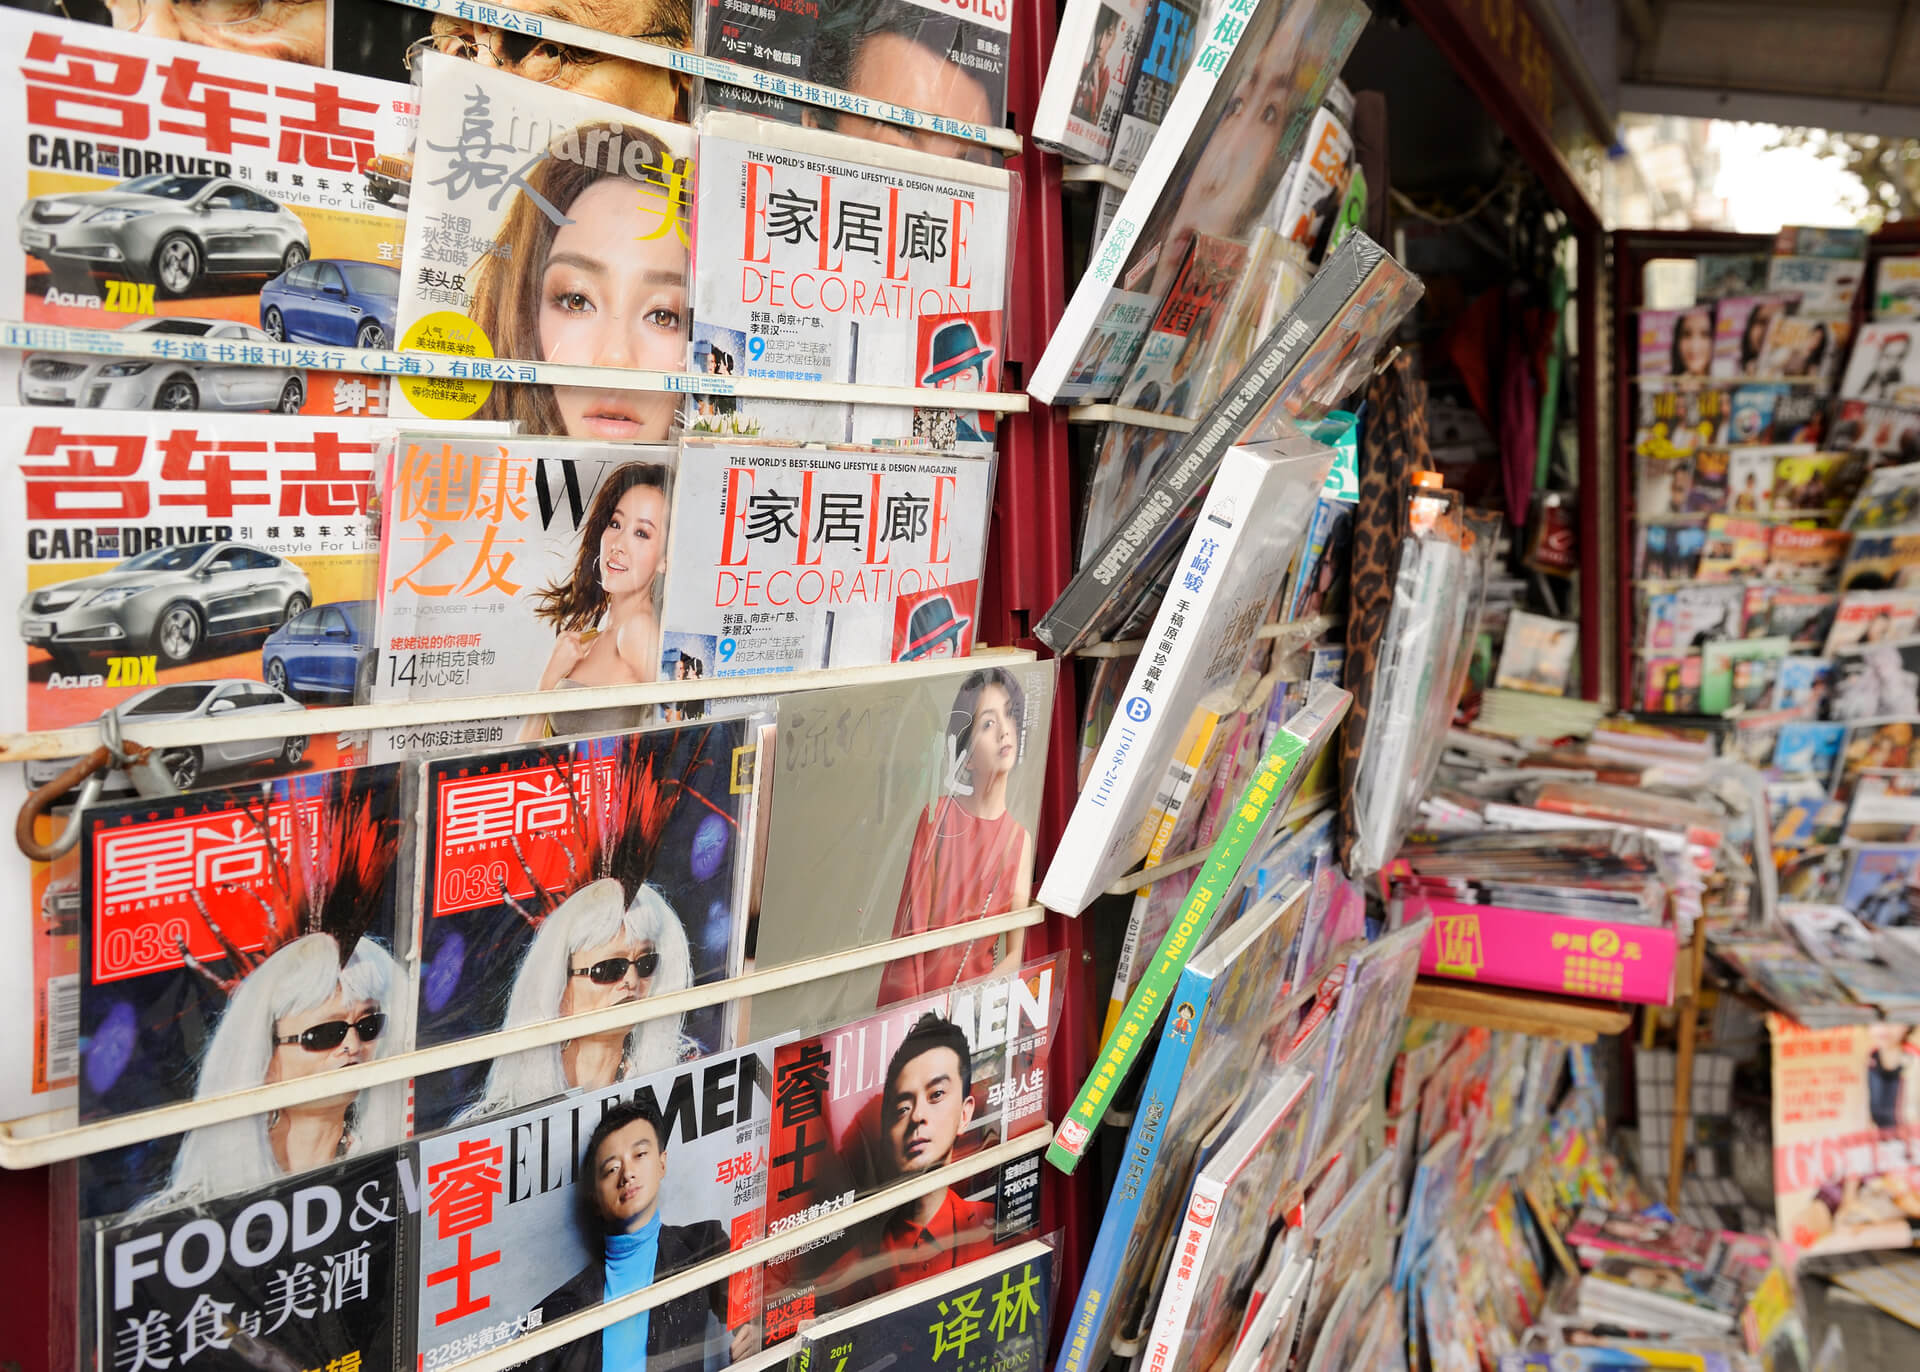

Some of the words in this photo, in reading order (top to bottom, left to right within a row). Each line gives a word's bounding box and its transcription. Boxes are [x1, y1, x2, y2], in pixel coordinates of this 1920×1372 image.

[754, 45, 801, 67] 这个敏感词
[19, 31, 380, 174] 名车志
[753, 72, 987, 142] 华道书报刊发行（上海）有限公司
[28, 133, 94, 173] CAR
[122, 147, 232, 178] DRIVER
[426, 84, 577, 226] 嘉人
[747, 150, 764, 162] THE
[766, 153, 805, 169] WORLD'S
[807, 161, 859, 178] BEST-SELLING
[861, 172, 896, 186] LIFESTYLE
[897, 178, 904, 187] &
[905, 179, 934, 193] DESIGN
[935, 185, 975, 200] MAGAZINE
[320, 194, 342, 206] For
[350, 198, 375, 211] Life
[421, 226, 513, 259] 秋冬彩妆热点
[424, 213, 471, 234] 一张图
[738, 160, 975, 289] ELLE
[766, 188, 950, 264] 家居廊
[421, 243, 469, 267] 全知晓
[44, 286, 101, 310] Acura
[104, 279, 156, 315] ZDX
[415, 286, 476, 309] 才有美肌肤
[418, 267, 466, 292] 美头皮
[741, 265, 971, 323] DECORATION
[416, 337, 476, 356] 美妆精英学院
[422, 325, 443, 338] 人气
[748, 336, 766, 362] 9
[152, 338, 537, 383] 华道书报刊发行（上海）有限公司
[730, 456, 747, 466] THE
[748, 457, 787, 468] WORLD'S
[788, 458, 841, 470] BEST-SELLING
[843, 460, 878, 471] LIFESTYLE
[880, 463, 886, 472] &
[888, 463, 917, 473] DESIGN
[918, 464, 957, 474] MAGAZINE
[1092, 540, 1134, 584] SUPER
[1170, 454, 1202, 489] SUPER
[1195, 417, 1231, 456] JUNIOR
[1225, 397, 1246, 418] THE
[1240, 376, 1262, 399] 3RD
[1258, 350, 1283, 377] ASIA
[1279, 320, 1307, 350] TOUR
[19, 426, 379, 520] 名车志
[393, 443, 533, 523] 健康
[714, 467, 956, 567] ELLE
[745, 489, 931, 545] 家居廊
[28, 527, 94, 559] CAR
[122, 526, 232, 558] DRIVER
[321, 541, 343, 551] For
[352, 541, 377, 551] Life
[392, 521, 525, 598] 之友
[715, 567, 950, 608] DECORATION
[390, 633, 482, 650] 姥姥说的你得听
[718, 637, 737, 663] 9
[47, 671, 103, 691] Acura
[106, 655, 158, 688] ZDX
[388, 654, 417, 687] 14
[420, 650, 496, 668] 种相克食物
[1130, 698, 1150, 721] B
[388, 727, 503, 750] 19个你没注意到的
[445, 838, 509, 857] CHANNE
[443, 860, 509, 905] 039
[105, 892, 188, 916] CHANNE
[104, 918, 190, 971] 039
[1133, 987, 1158, 1021] 2011
[773, 1044, 831, 1202] 睿士
[114, 1184, 341, 1311] FOOD
[349, 1180, 398, 1232] &
[427, 1138, 504, 1327] 睿士
[113, 1239, 371, 1372] 美食与美酒
[929, 1264, 1041, 1362] 译林
[425, 1307, 543, 1369] 328米黄金大厦
[830, 1342, 853, 1361] 2011
